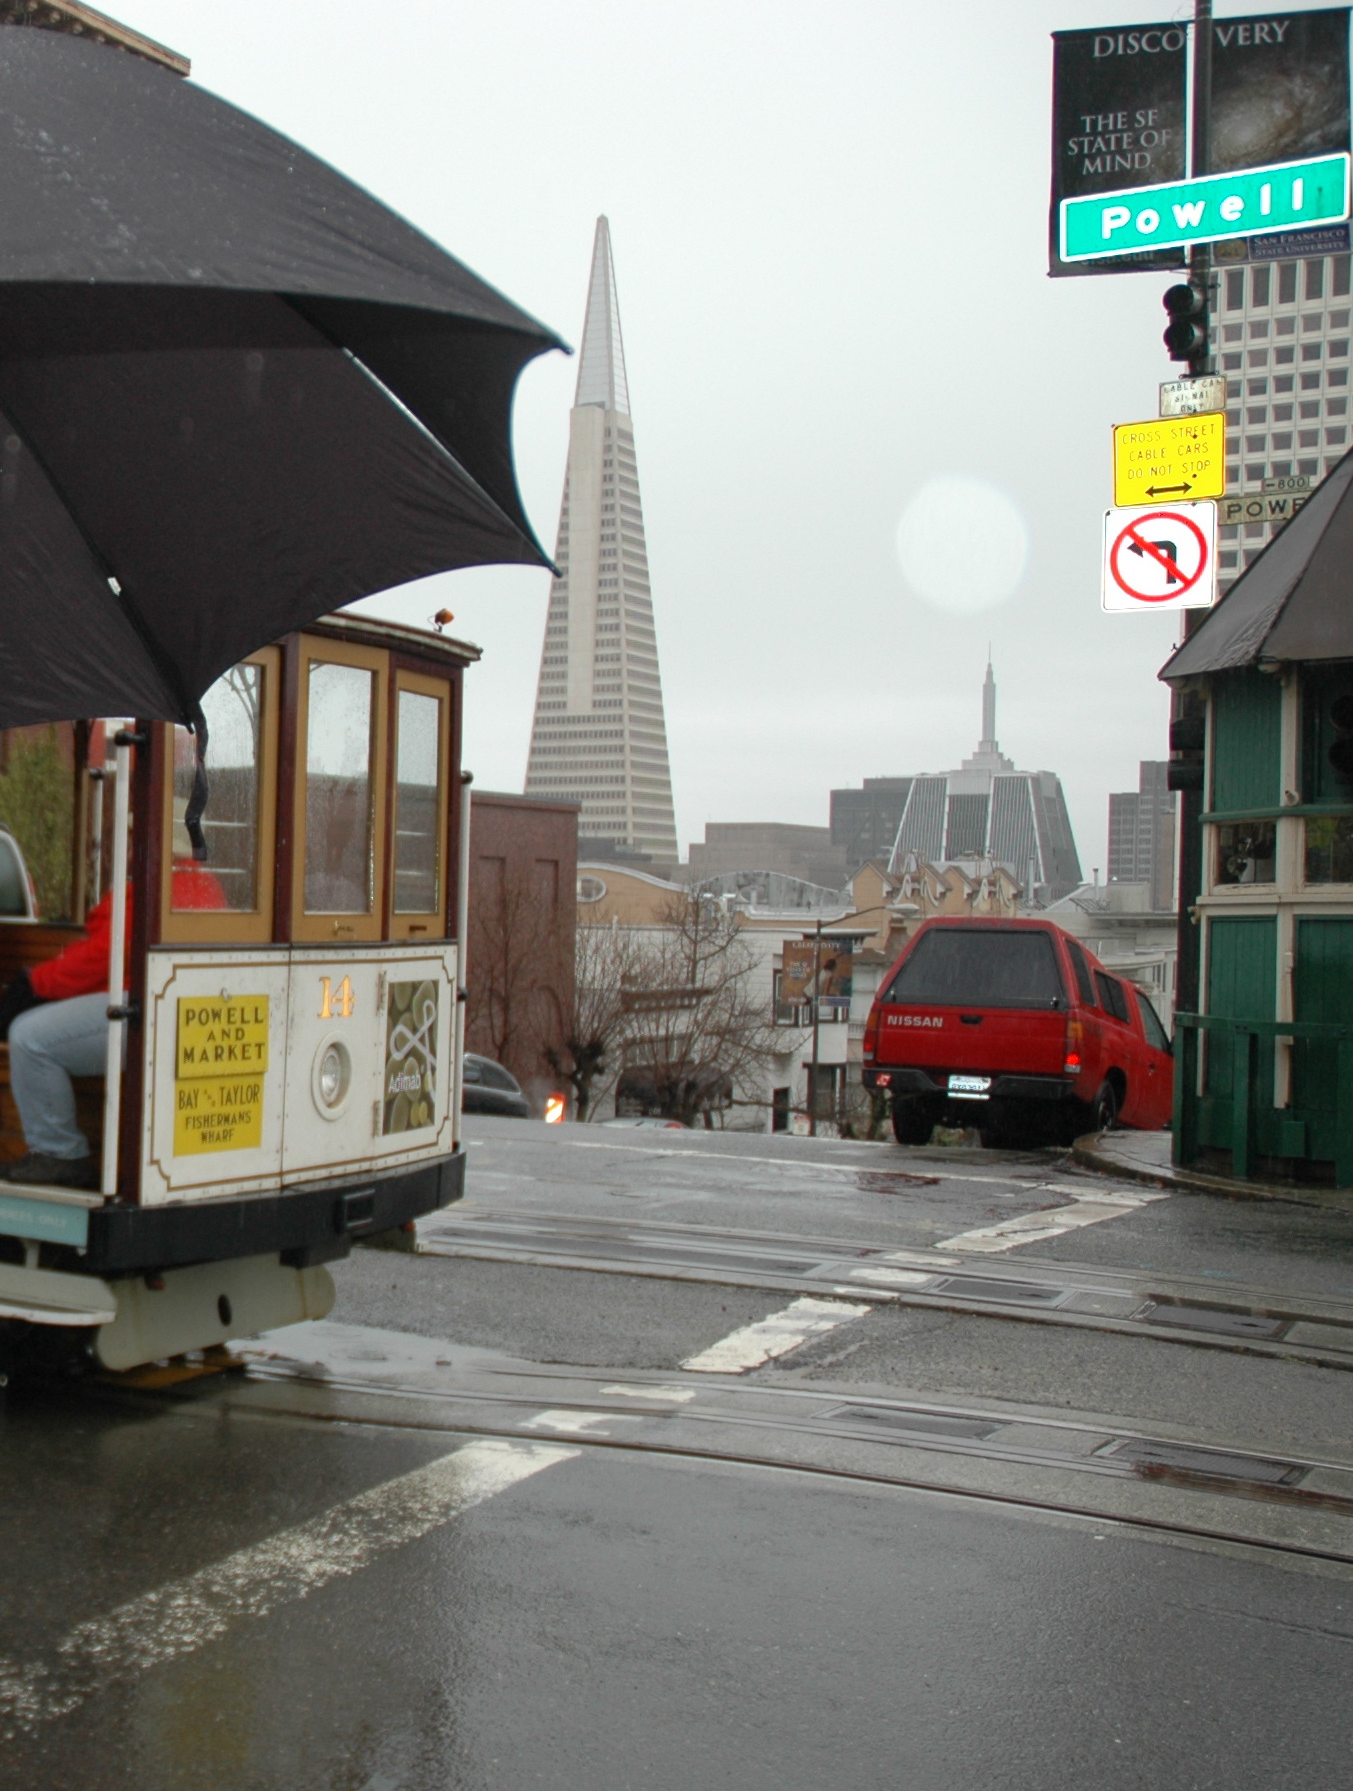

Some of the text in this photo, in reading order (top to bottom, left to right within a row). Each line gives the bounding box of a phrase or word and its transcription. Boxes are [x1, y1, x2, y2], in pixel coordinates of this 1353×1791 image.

[1081, 109, 1158, 133] THE SF
[1067, 128, 1172, 156] STATE OF
[1082, 152, 1151, 176] MIND
[1101, 178, 1304, 240] Powell
[1122, 424, 1215, 445] CROSS STREET
[1129, 442, 1209, 461] CABLE CARS
[1128, 459, 1211, 480] DO NOT STOP
[1227, 496, 1306, 519] POWE
[317, 974, 356, 1020] 14
[185, 1004, 265, 1027] POWELL
[887, 1015, 944, 1028] NISSAN
[206, 1026, 246, 1042] AND
[182, 1042, 266, 1065] MARKET
[178, 1088, 200, 1111] BAY
[219, 1083, 261, 1107] TAYLOR
[200, 1127, 235, 1145] WHARF
